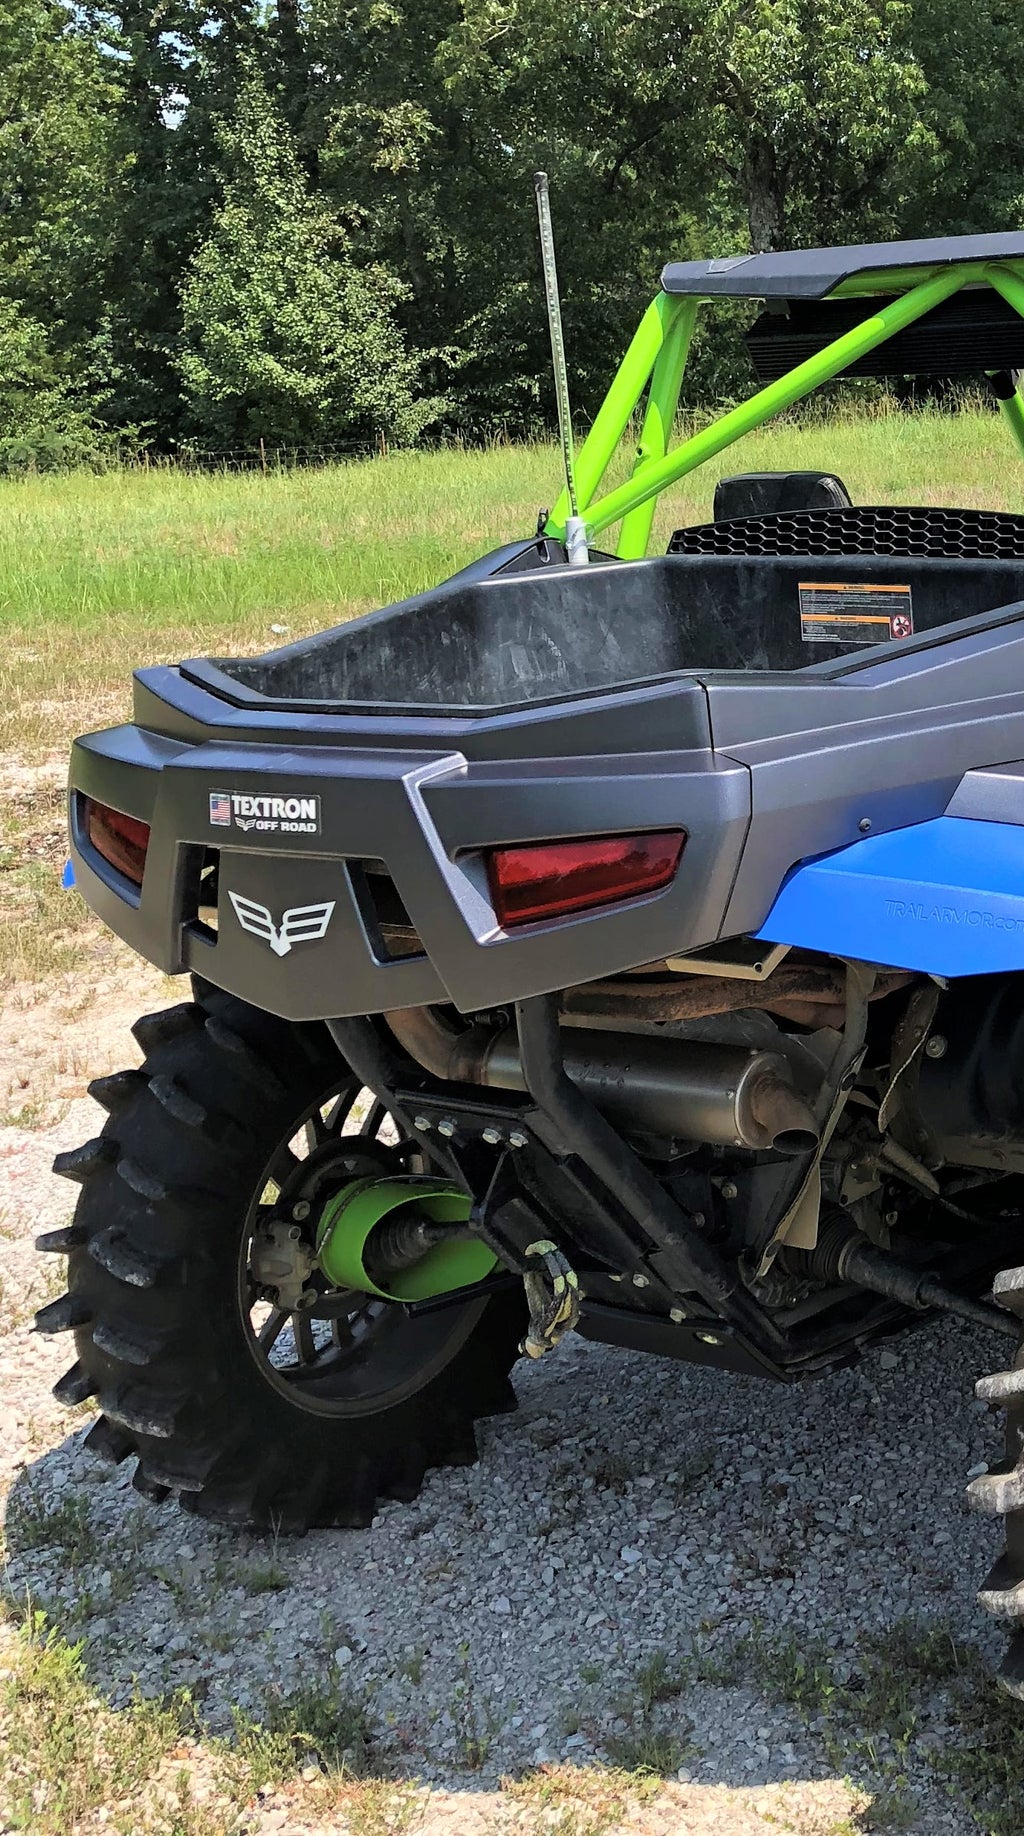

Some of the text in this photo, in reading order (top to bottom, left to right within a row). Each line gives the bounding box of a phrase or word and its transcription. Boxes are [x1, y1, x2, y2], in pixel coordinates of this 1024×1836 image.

[231, 795, 316, 820] TEXTRON
[255, 820, 317, 833] OFF ROAD
